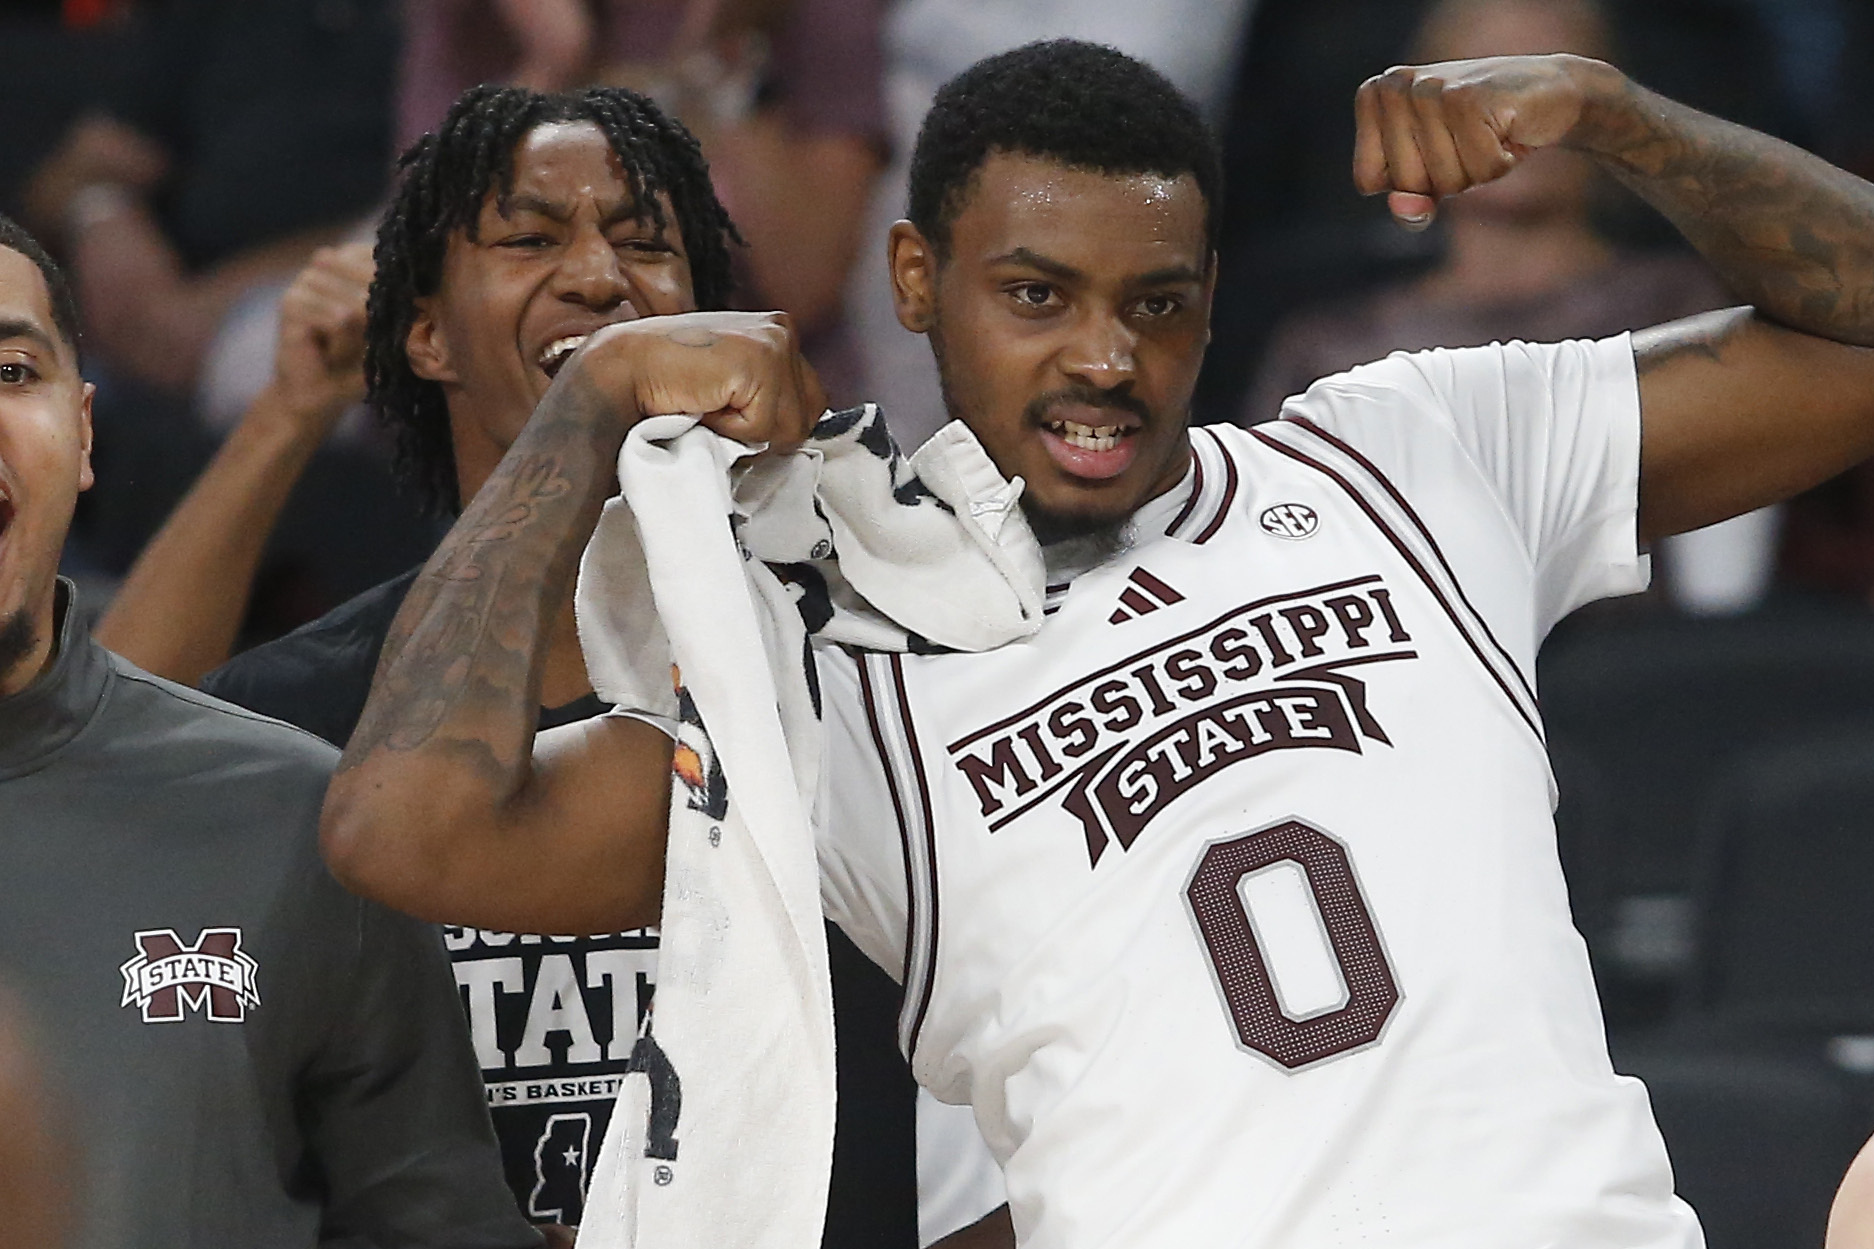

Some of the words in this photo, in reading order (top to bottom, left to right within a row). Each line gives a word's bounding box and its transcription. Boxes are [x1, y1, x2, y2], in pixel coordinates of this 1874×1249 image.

[1262, 503, 1318, 537] SEC
[955, 587, 1413, 818] MISSISSIPPI
[1114, 694, 1335, 817] STATE
[149, 957, 235, 987] STATE
[1179, 814, 1407, 1077] 0
[527, 1078, 624, 1099] BASKET
